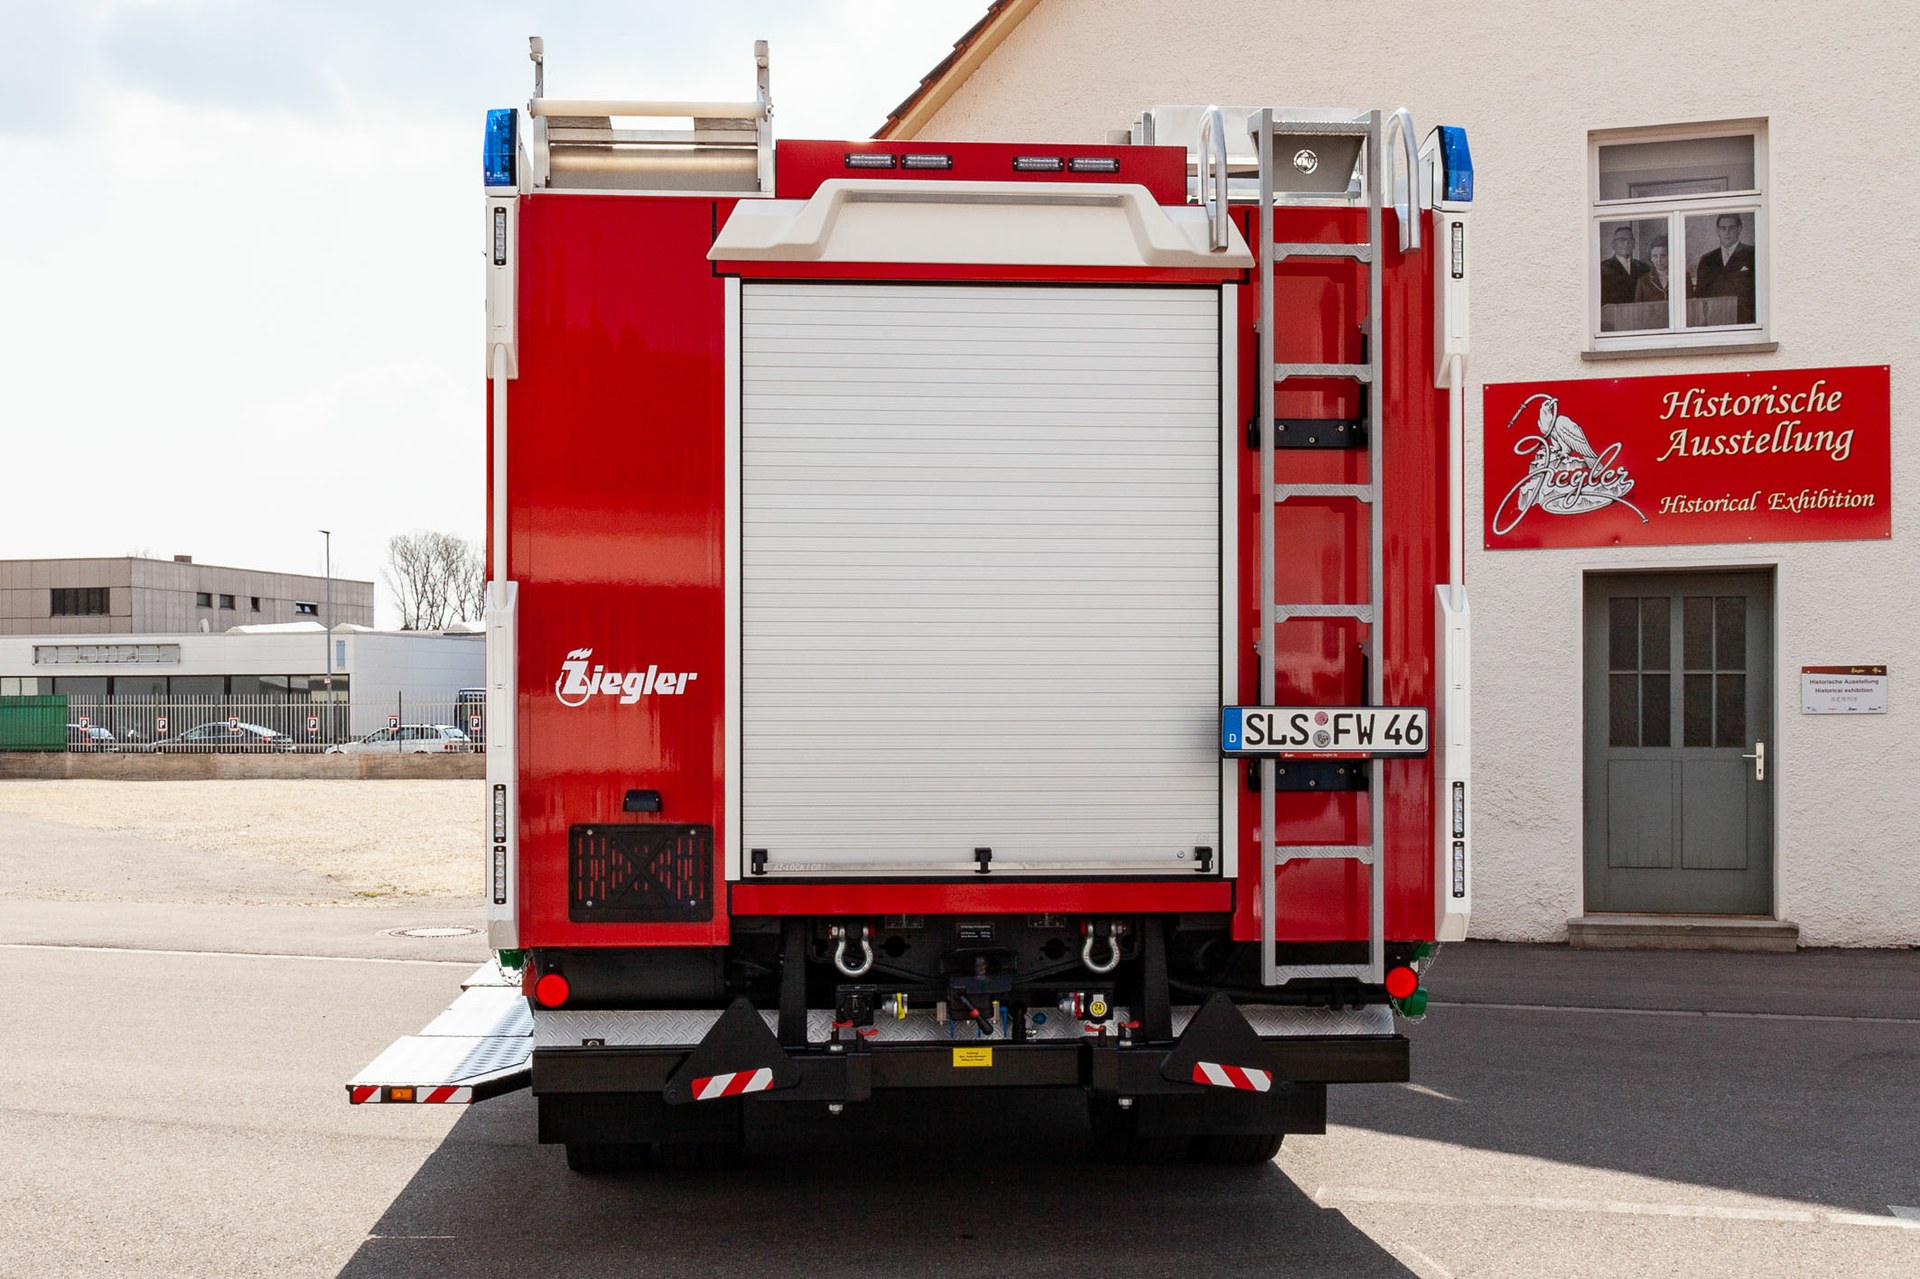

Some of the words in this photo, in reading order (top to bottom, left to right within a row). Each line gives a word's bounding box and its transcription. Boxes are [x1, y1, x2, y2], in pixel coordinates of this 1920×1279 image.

[1659, 380, 1842, 420] Historische
[1656, 420, 1855, 462] Ausstellung
[1659, 490, 1761, 515] Historical
[1767, 488, 1875, 514] Exhibition
[554, 648, 698, 708] Ziegler
[1843, 678, 1879, 686] Ausstellung
[1228, 733, 1237, 743] D
[1244, 713, 1310, 746] SLS
[1333, 713, 1376, 746] FW
[1383, 714, 1424, 746] 46
